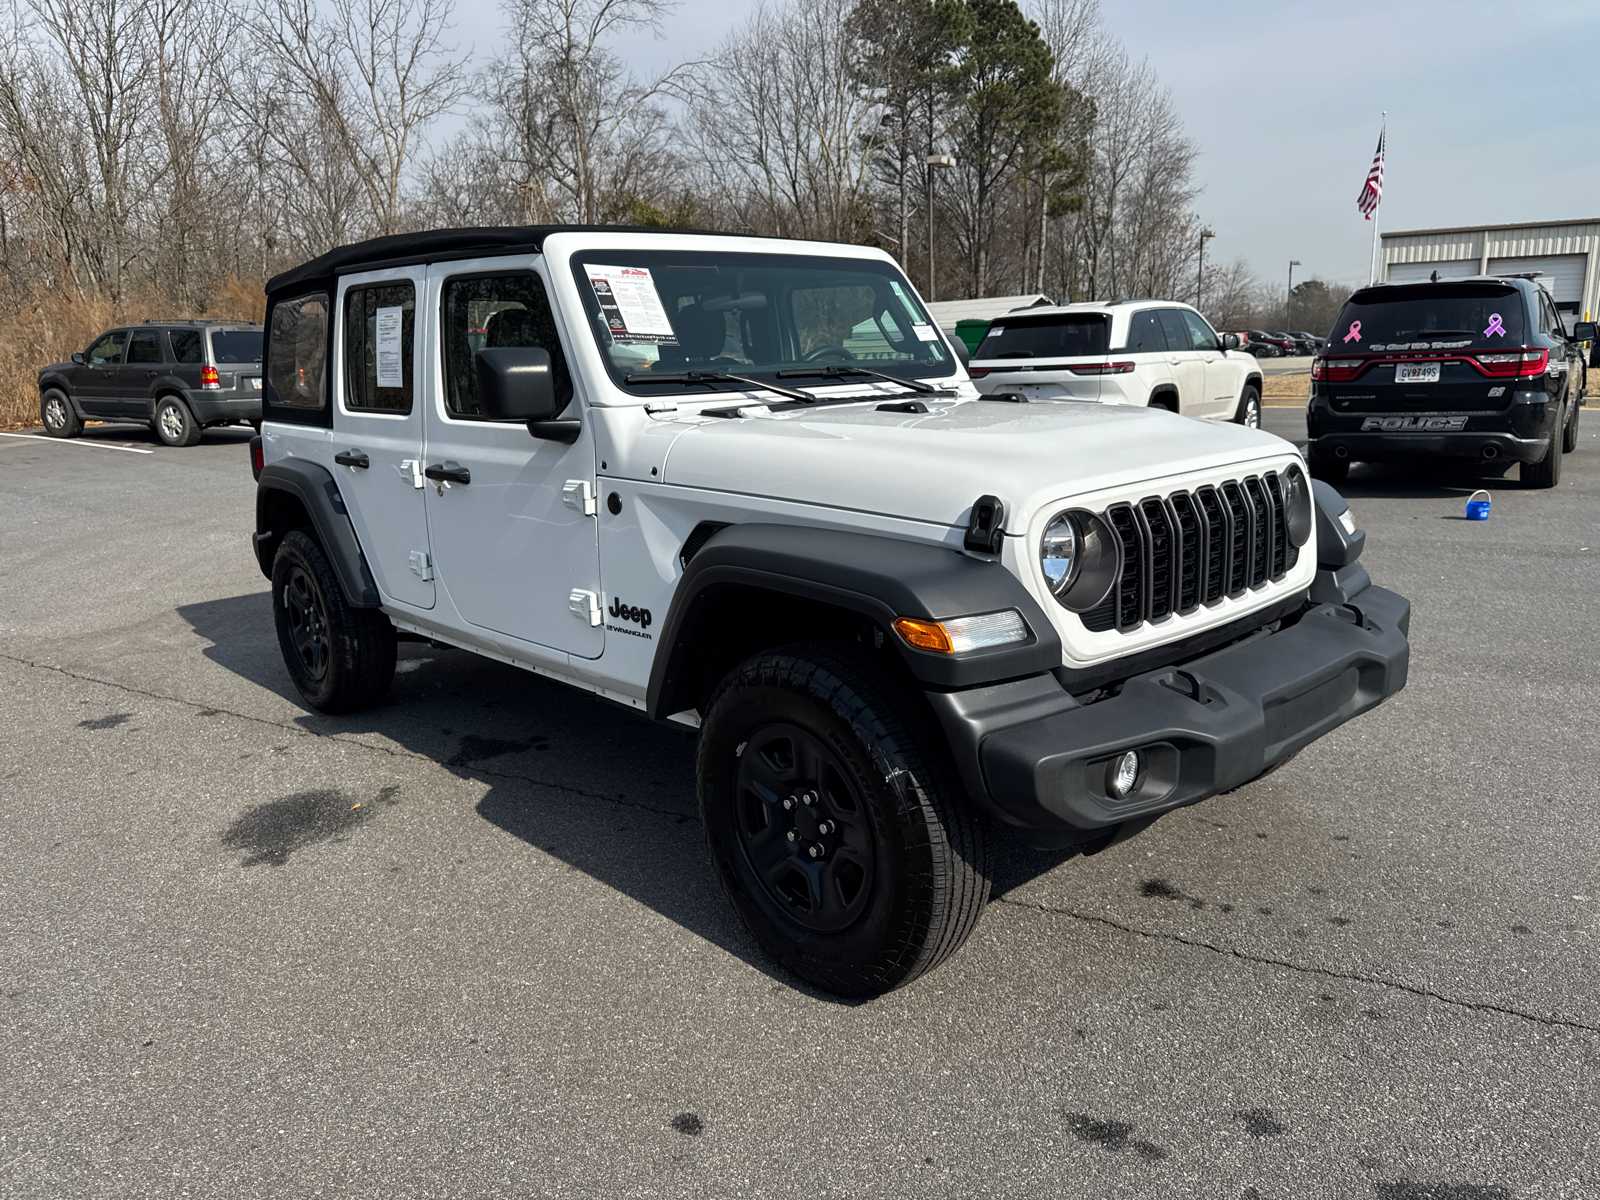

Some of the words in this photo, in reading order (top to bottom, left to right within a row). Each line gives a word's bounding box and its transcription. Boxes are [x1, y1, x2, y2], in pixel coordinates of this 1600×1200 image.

[1386, 343, 1410, 351] God
[1360, 416, 1469, 432] POLICE
[608, 596, 652, 629] Jeep
[612, 625, 652, 640] WRANGLER
